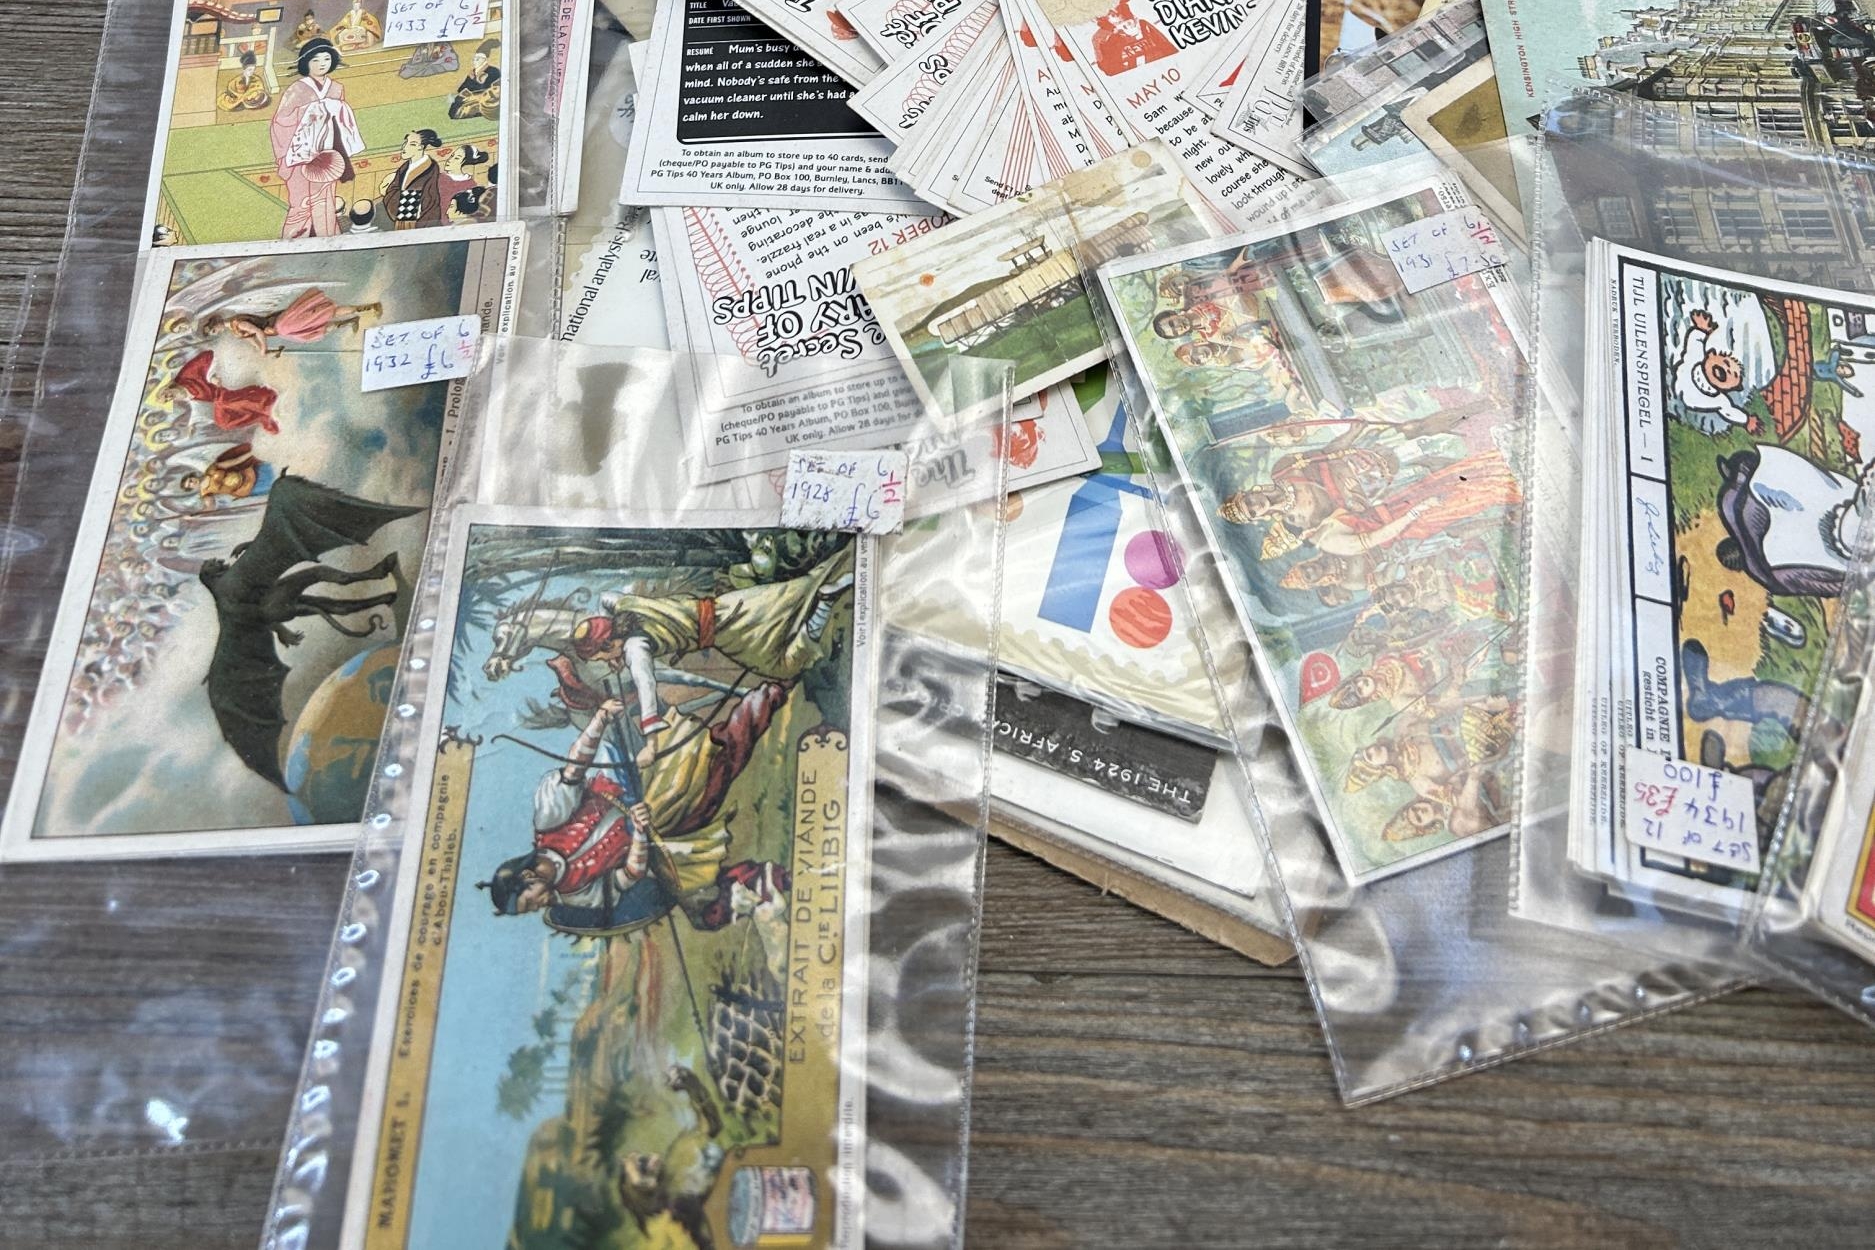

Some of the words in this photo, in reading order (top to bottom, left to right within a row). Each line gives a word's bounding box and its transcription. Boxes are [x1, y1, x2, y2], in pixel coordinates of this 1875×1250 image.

[391, 2, 416, 15] SET
[424, 0, 444, 10] OF
[561, 8, 571, 22] DE
[688, 16, 705, 25] DATE
[706, 15, 725, 23] FIRST
[726, 14, 751, 23] SHOWN
[690, 1, 708, 9] TITLE
[387, 19, 426, 33] 1933
[1169, 5, 1249, 49] KEVIN
[1512, 20, 1523, 40] HIGH
[728, 44, 763, 55] Mum's
[765, 43, 790, 53] busy
[685, 62, 713, 72] when
[716, 60, 729, 70] all
[731, 60, 744, 69] of
[754, 60, 793, 69] sudden
[796, 58, 815, 68] she
[1517, 44, 1535, 98] KENSINGTON
[684, 78, 714, 88] mind.
[717, 75, 765, 88] Nobody's
[767, 75, 791, 85] safe
[793, 74, 819, 84] from
[821, 73, 840, 83] the
[1126, 78, 1162, 110] MAY
[1162, 68, 1180, 86] 10
[683, 95, 724, 105] vacuum
[726, 92, 768, 103] cleaner
[769, 91, 794, 101] until
[796, 90, 825, 100] she's
[826, 89, 846, 99] had
[682, 112, 708, 122] calm
[710, 110, 729, 120] her
[731, 109, 765, 119] down.
[1156, 102, 1194, 134] because
[666, 170, 684, 179] Tips
[686, 170, 698, 178] 40
[700, 171, 723, 179] Years
[725, 171, 756, 180] Album,
[758, 172, 772, 180] PO
[814, 174, 850, 184] Burnley,
[852, 176, 879, 186] Lancs,
[710, 182, 723, 190] UK
[748, 183, 774, 191] Allow
[790, 184, 811, 194] days
[813, 185, 826, 193] for
[828, 186, 865, 196] delivery.
[1222, 172, 1252, 198] course
[1252, 156, 1270, 174] she
[1232, 192, 1254, 210] look
[1250, 166, 1290, 196] through
[892, 208, 952, 244] TOBER
[511, 236, 521, 262] verso
[868, 238, 890, 256] 12
[712, 280, 806, 325] TIPPS
[1632, 276, 1646, 307] TIJL
[371, 329, 410, 349] SET
[421, 325, 444, 340] OF
[458, 319, 469, 337] 6
[754, 310, 804, 348] OF
[365, 353, 412, 372] 1932
[756, 328, 864, 378] Secret
[1634, 313, 1652, 429] UILENSPIEGEL
[877, 455, 888, 477] 6
[1643, 670, 1656, 723] gesticht
[1655, 656, 1672, 743] COMPAGNIE
[1646, 727, 1656, 740] in
[1068, 746, 1082, 762] S.
[1094, 758, 1142, 784] 1924
[1664, 763, 1723, 802] £100
[1148, 776, 1190, 804] THE
[797, 769, 817, 876] VIANDE
[1684, 798, 1745, 834] 1934
[417, 883, 435, 948] courage
[432, 774, 451, 851] compagnie
[823, 799, 841, 914] LIEBIG
[796, 887, 812, 923] DE
[789, 939, 810, 1064] EXTRAIT
